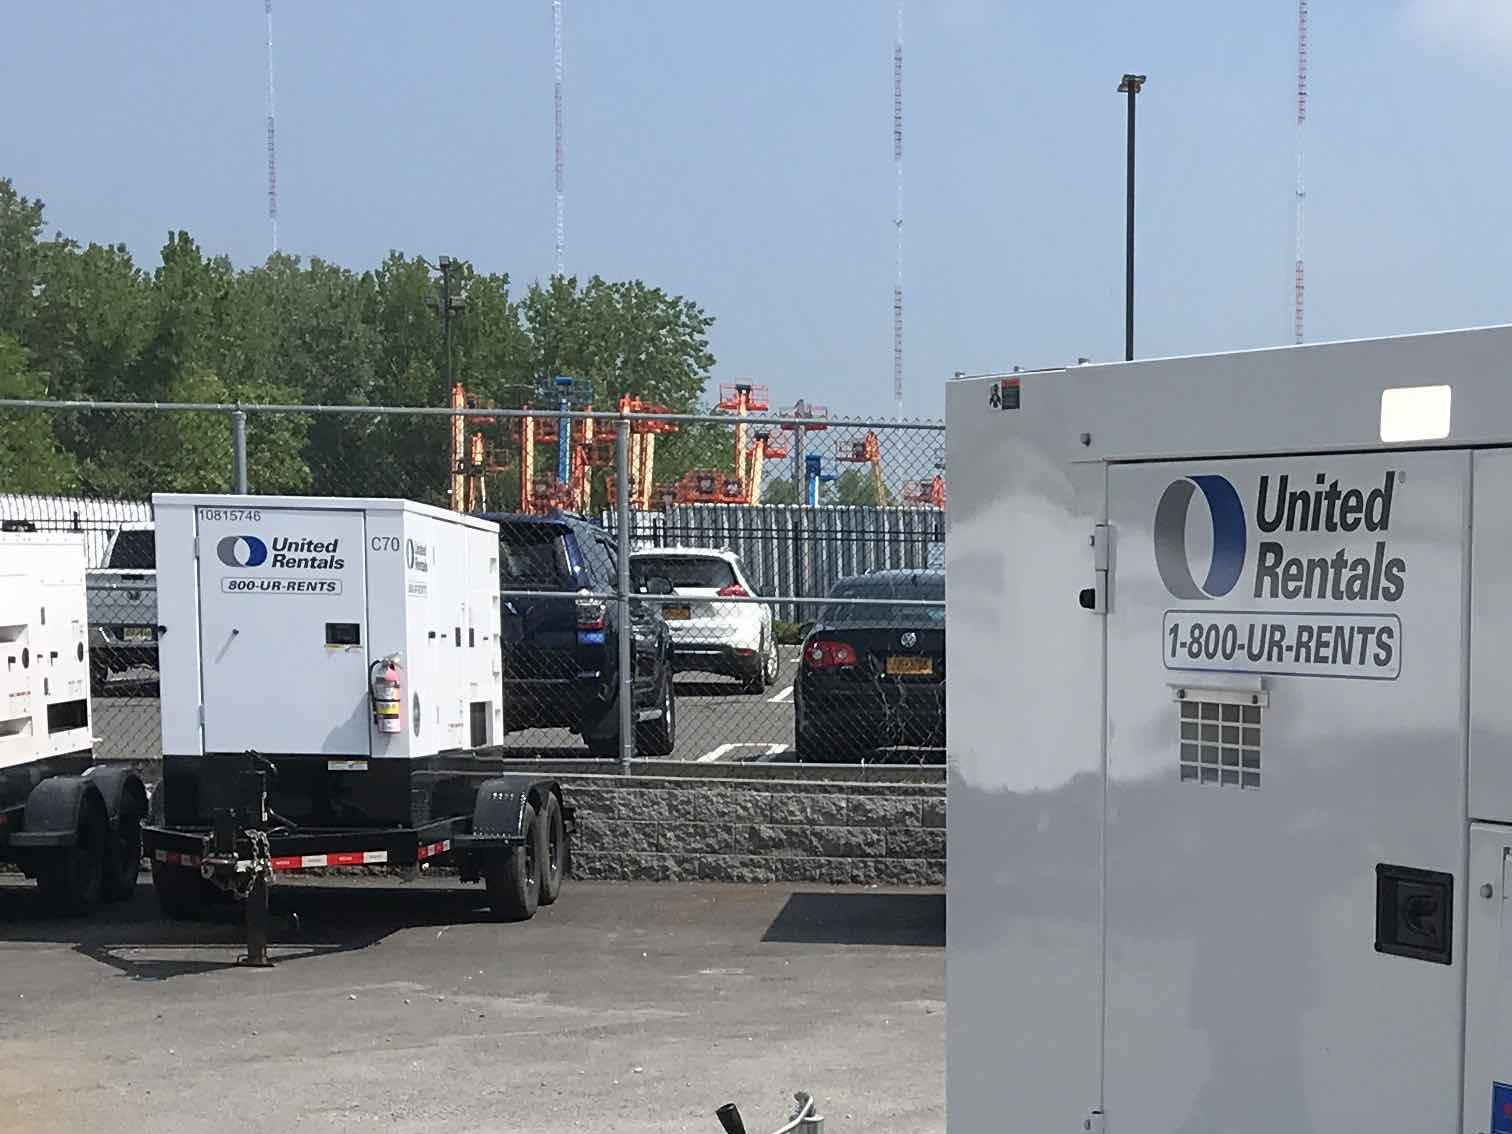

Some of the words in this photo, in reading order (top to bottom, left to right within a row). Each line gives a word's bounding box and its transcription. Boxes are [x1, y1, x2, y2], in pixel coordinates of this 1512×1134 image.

[1256, 470, 1396, 533] United
[199, 510, 262, 522] 10815746
[271, 537, 339, 554] United
[371, 536, 400, 552] C70
[271, 554, 345, 570] Rentals
[1253, 541, 1406, 602] Rentals
[227, 580, 337, 593] 800-UR-RENTS
[1168, 622, 1394, 667] 1-800-UR-RENTS
